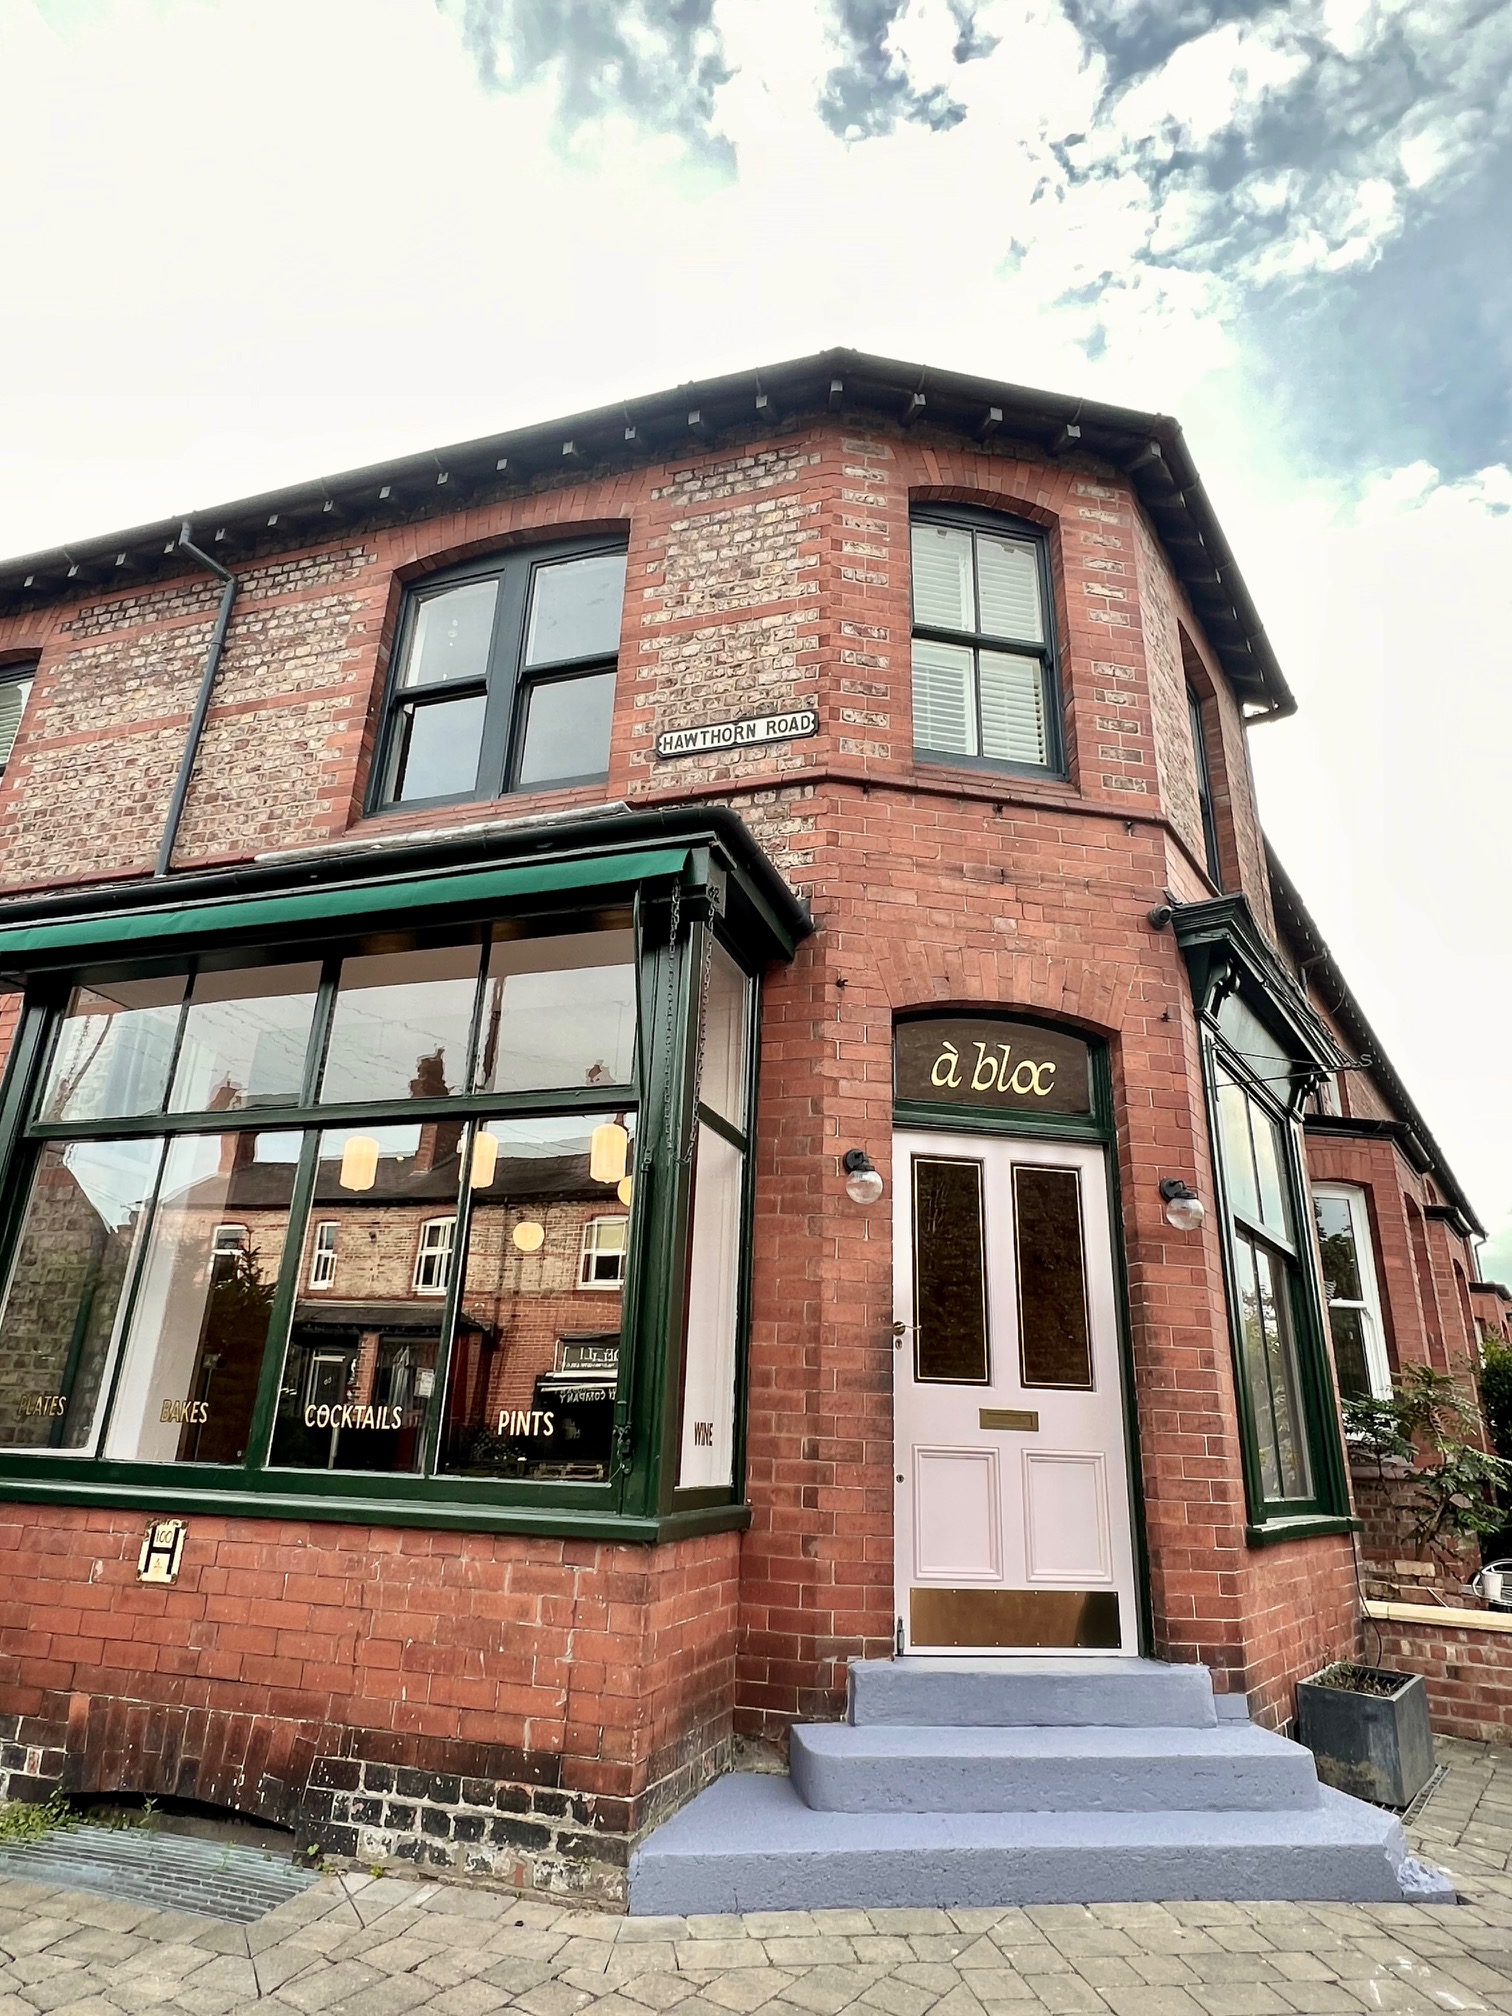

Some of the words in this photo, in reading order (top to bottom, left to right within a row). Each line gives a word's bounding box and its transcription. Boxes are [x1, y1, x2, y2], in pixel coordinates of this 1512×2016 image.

[663, 723, 756, 751] HAWTHORN
[766, 715, 811, 736] ROAD
[930, 1041, 963, 1088] à
[970, 1041, 1057, 1096] bloc
[17, 1395, 67, 1417] PLATES
[160, 1399, 209, 1423] BAKES
[304, 1404, 403, 1430] COCKTAILS
[498, 1410, 555, 1436] PINTS
[694, 1421, 714, 1447] WINE
[143, 1525, 181, 1575] H
